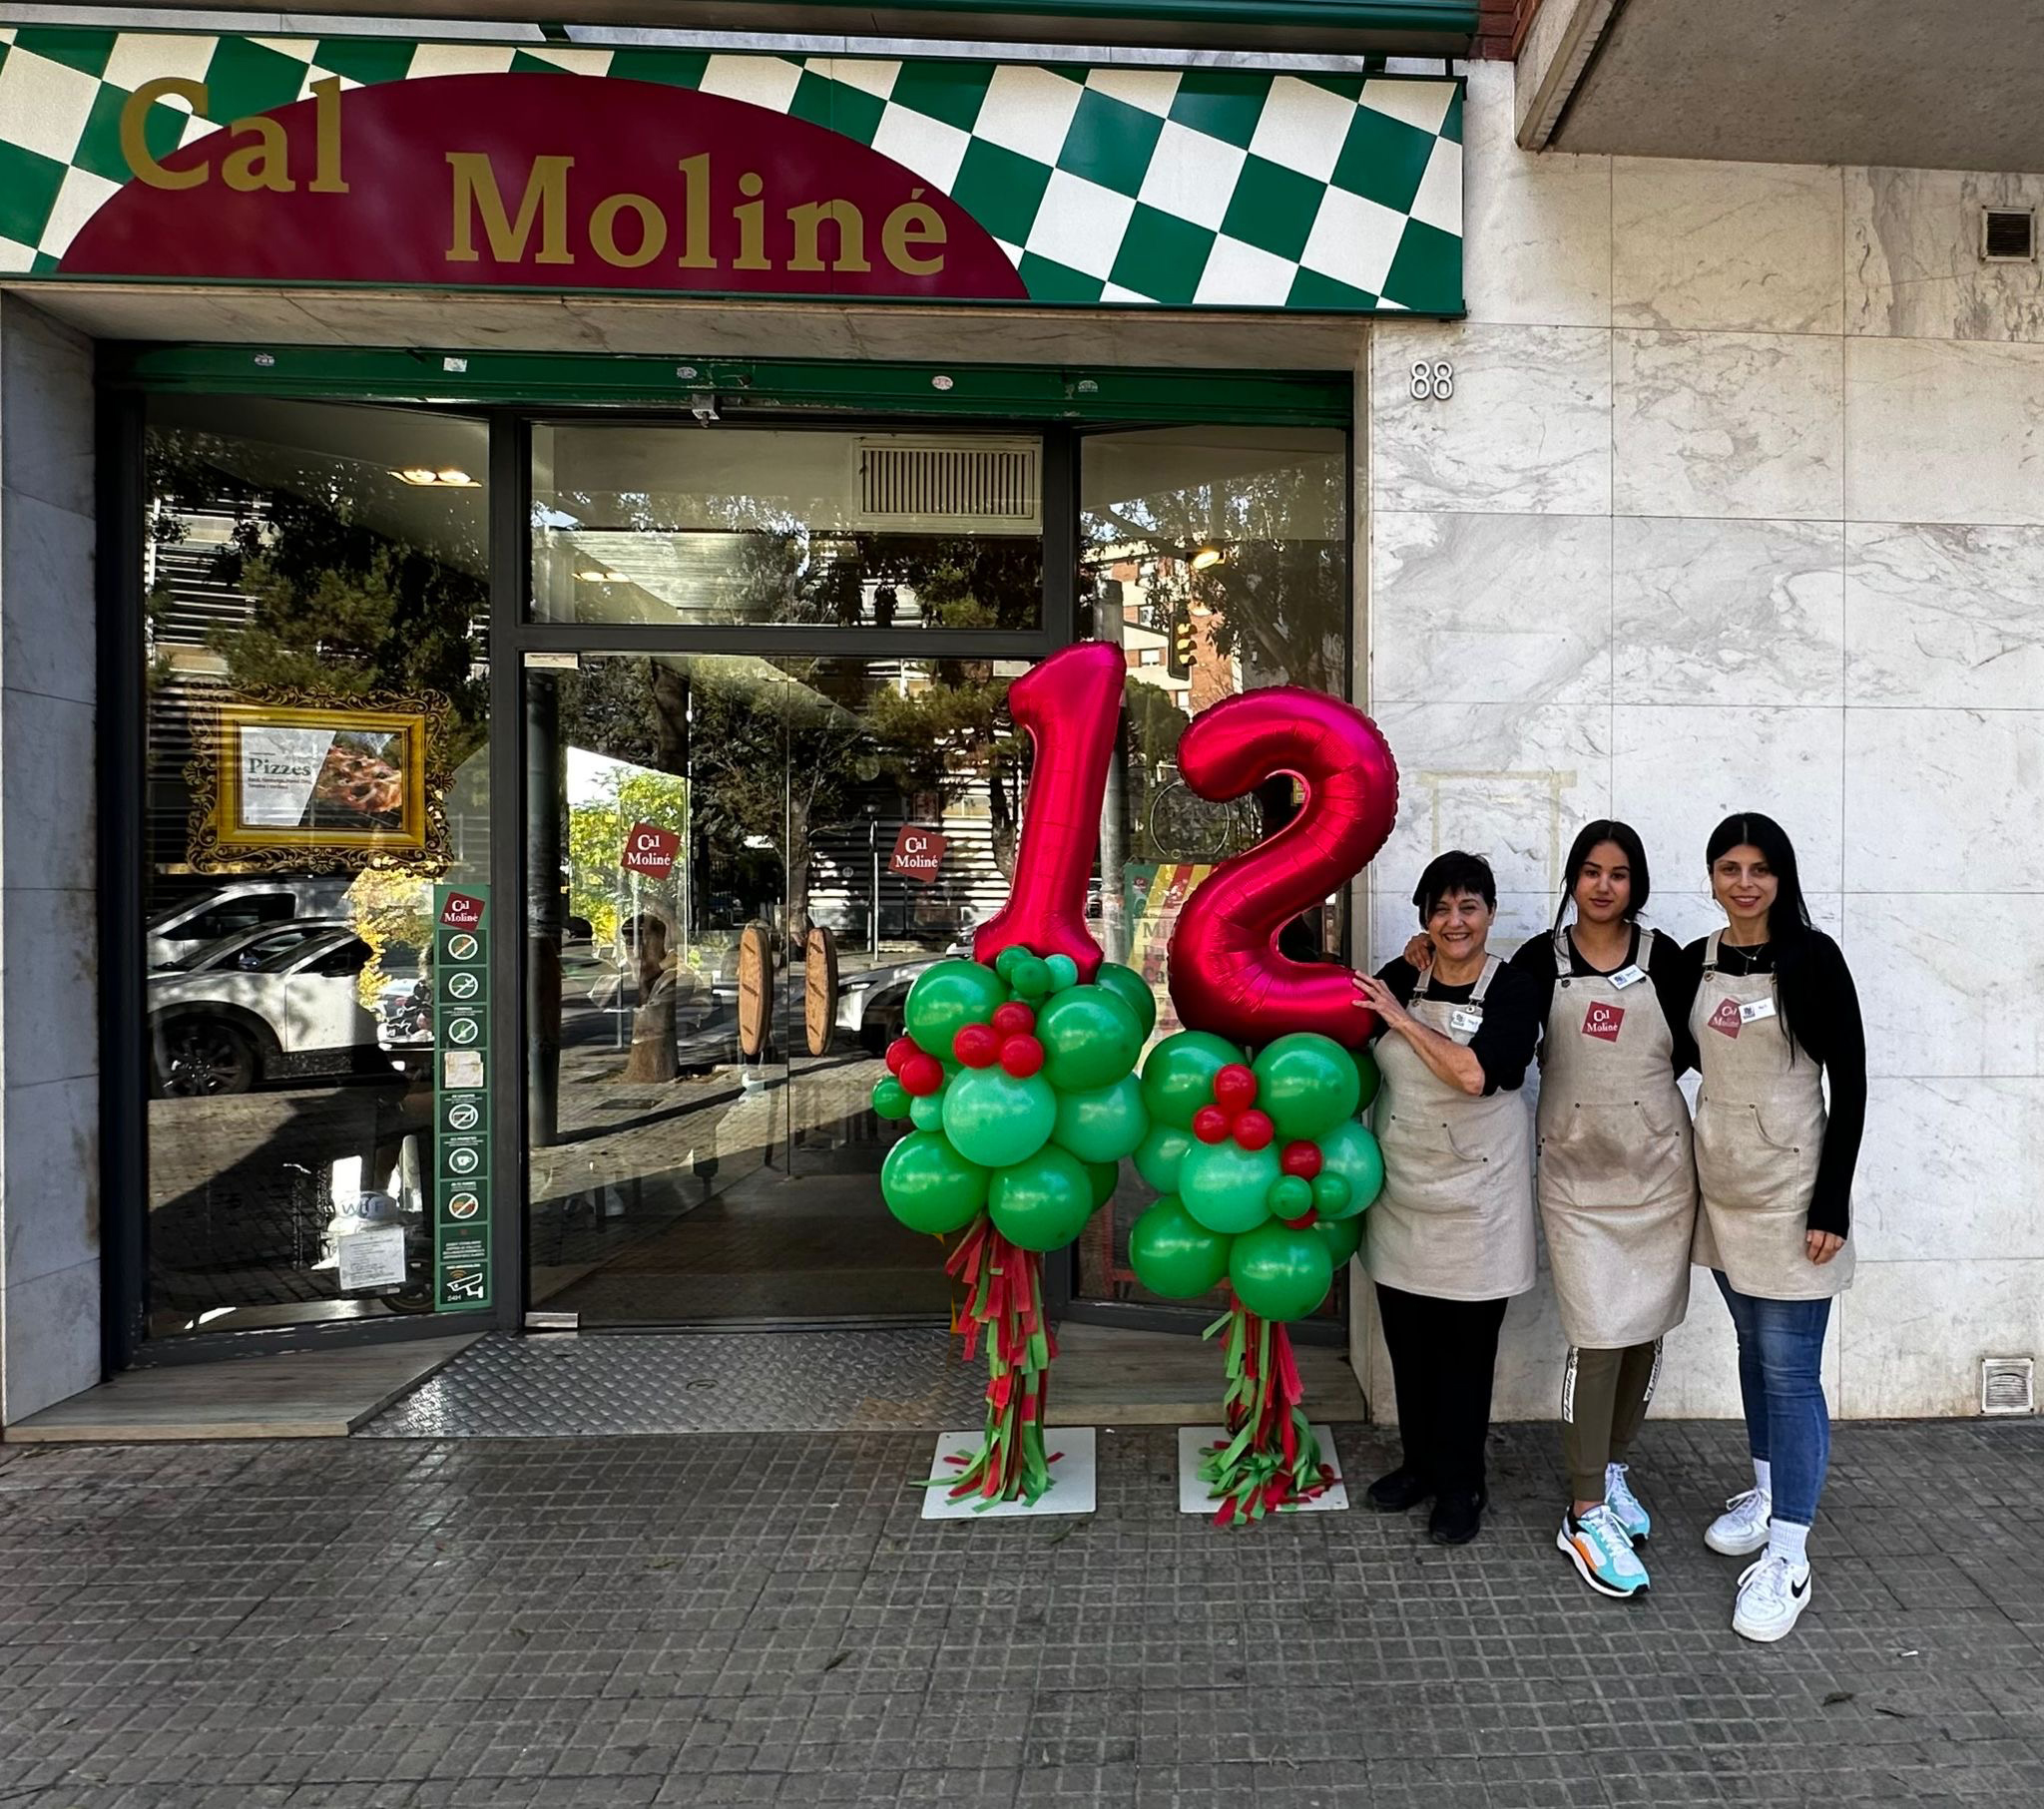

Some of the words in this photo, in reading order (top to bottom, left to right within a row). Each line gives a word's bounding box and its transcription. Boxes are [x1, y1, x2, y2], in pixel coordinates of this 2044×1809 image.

[120, 76, 349, 193] Cal
[445, 152, 947, 276] Moliné
[1410, 360, 1453, 400] 88
[248, 757, 311, 776] Pizzes
[637, 834, 661, 851] Cal
[904, 837, 927, 853] Cal
[627, 852, 672, 866] Moliné
[895, 854, 938, 868] Moliné
[451, 900, 470, 912] Cal
[1593, 1010, 1610, 1023] Cal
